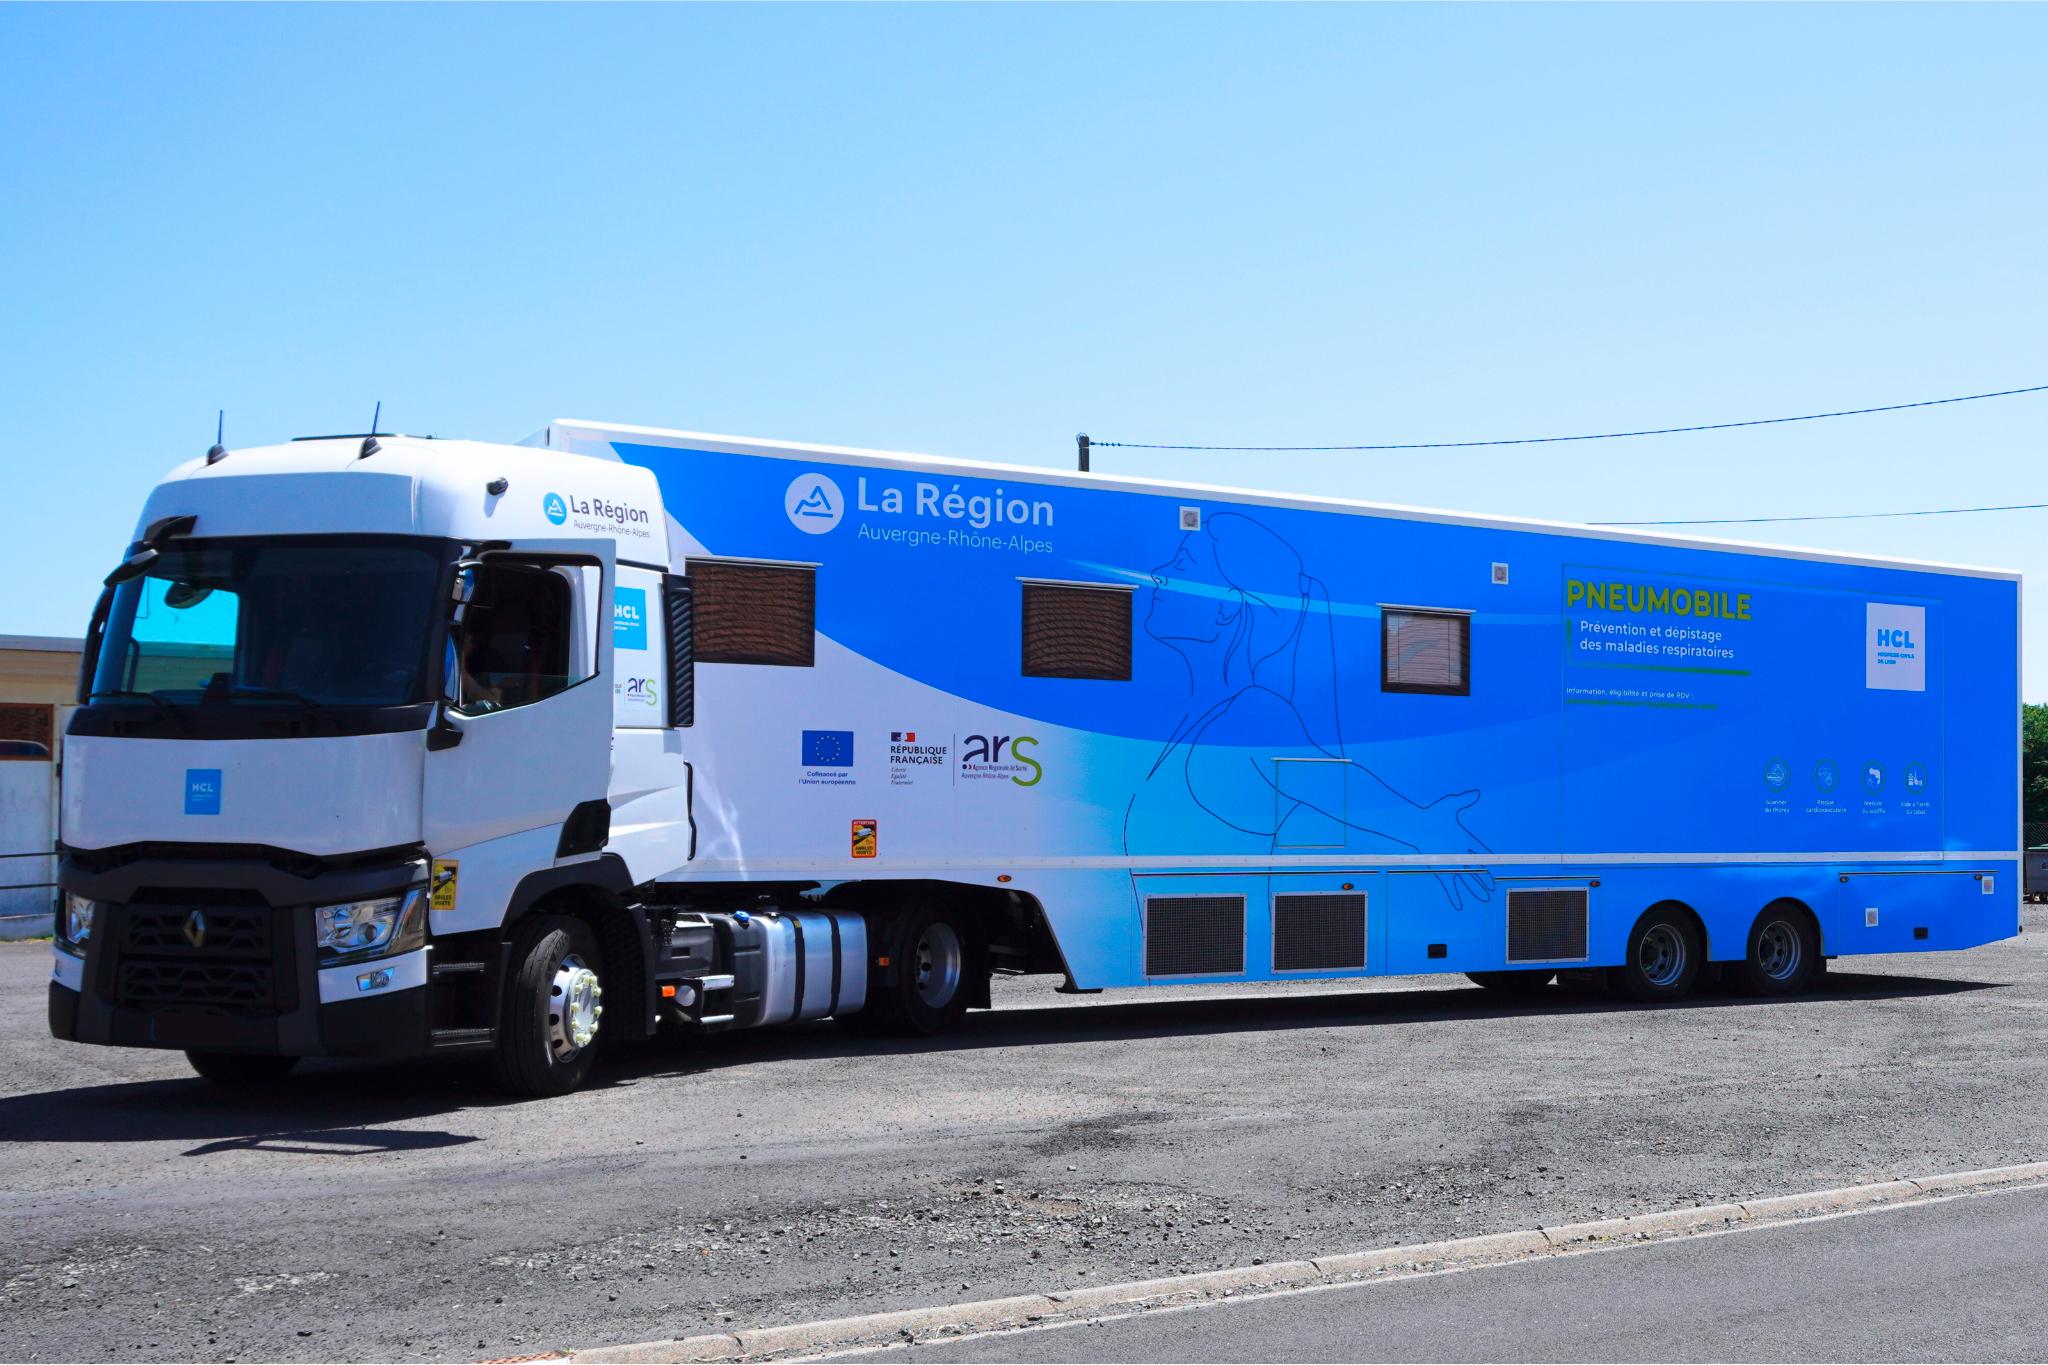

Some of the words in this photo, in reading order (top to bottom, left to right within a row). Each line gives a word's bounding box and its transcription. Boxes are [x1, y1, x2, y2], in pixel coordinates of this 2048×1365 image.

[569, 494, 590, 515] La
[592, 497, 649, 524] Région
[859, 477, 903, 514] La
[916, 482, 1054, 529] Région
[573, 519, 651, 538] Auvergne-Rhône-Alpes
[857, 522, 1054, 555] Auvergne-Rhône-Alpes
[1567, 579, 1752, 620] PNEUMOBILE
[1580, 620, 1646, 637] Prévention
[1649, 625, 1662, 638] et
[1664, 626, 1722, 643] dépistage
[1877, 628, 1915, 649] HCL
[1579, 638, 1601, 651] des
[1605, 640, 1660, 655] maladies
[1662, 644, 1735, 660] respiratoires
[1566, 687, 1608, 697] Information,
[1641, 690, 1648, 698] et
[1649, 690, 1666, 700] prise
[1666, 690, 1675, 699] de
[890, 743, 948, 756] RÉPUBLIQUE
[890, 755, 943, 766] FRANÇAISE
[191, 783, 214, 792] HCL
